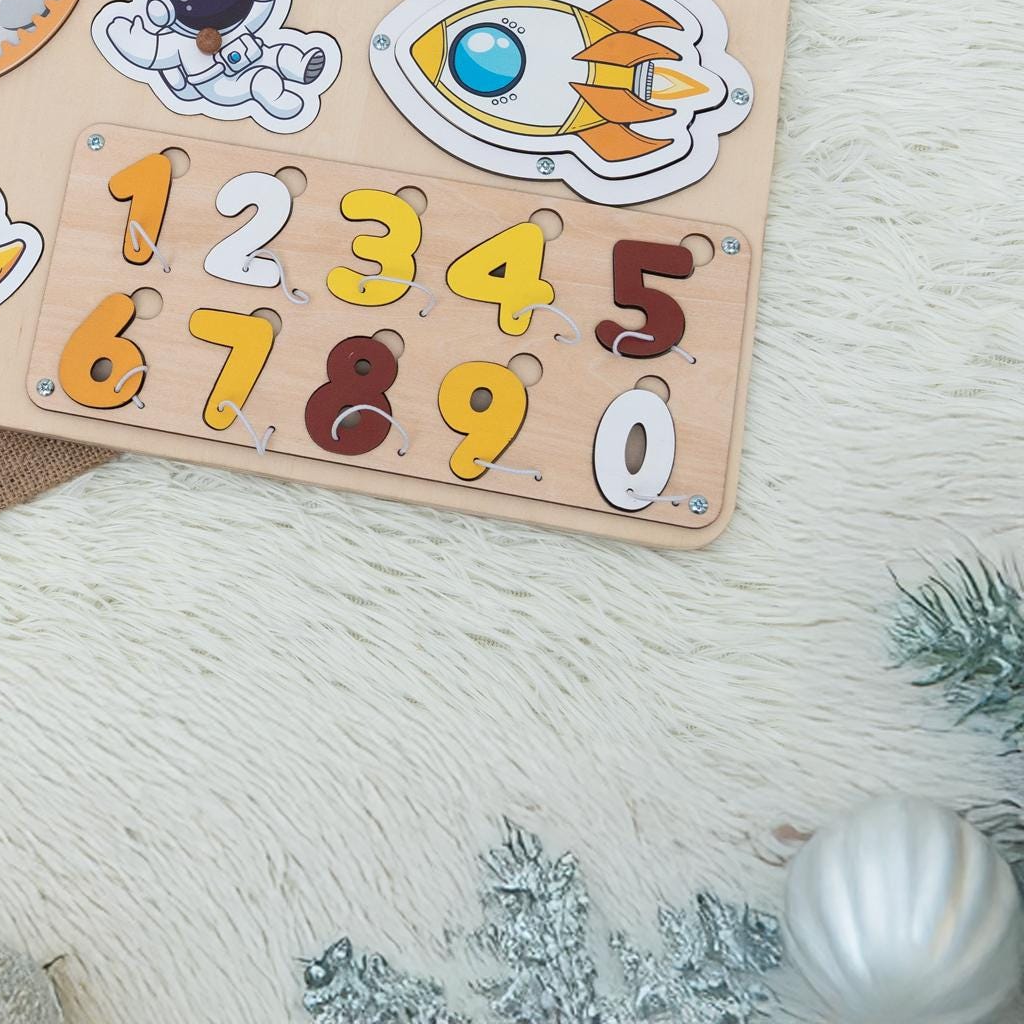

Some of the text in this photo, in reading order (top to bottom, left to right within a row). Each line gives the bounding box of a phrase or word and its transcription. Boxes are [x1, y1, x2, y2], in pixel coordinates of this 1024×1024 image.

[108, 152, 694, 359] 1 2 3 4 5
[59, 292, 676, 512] 6 7 8 9 0
